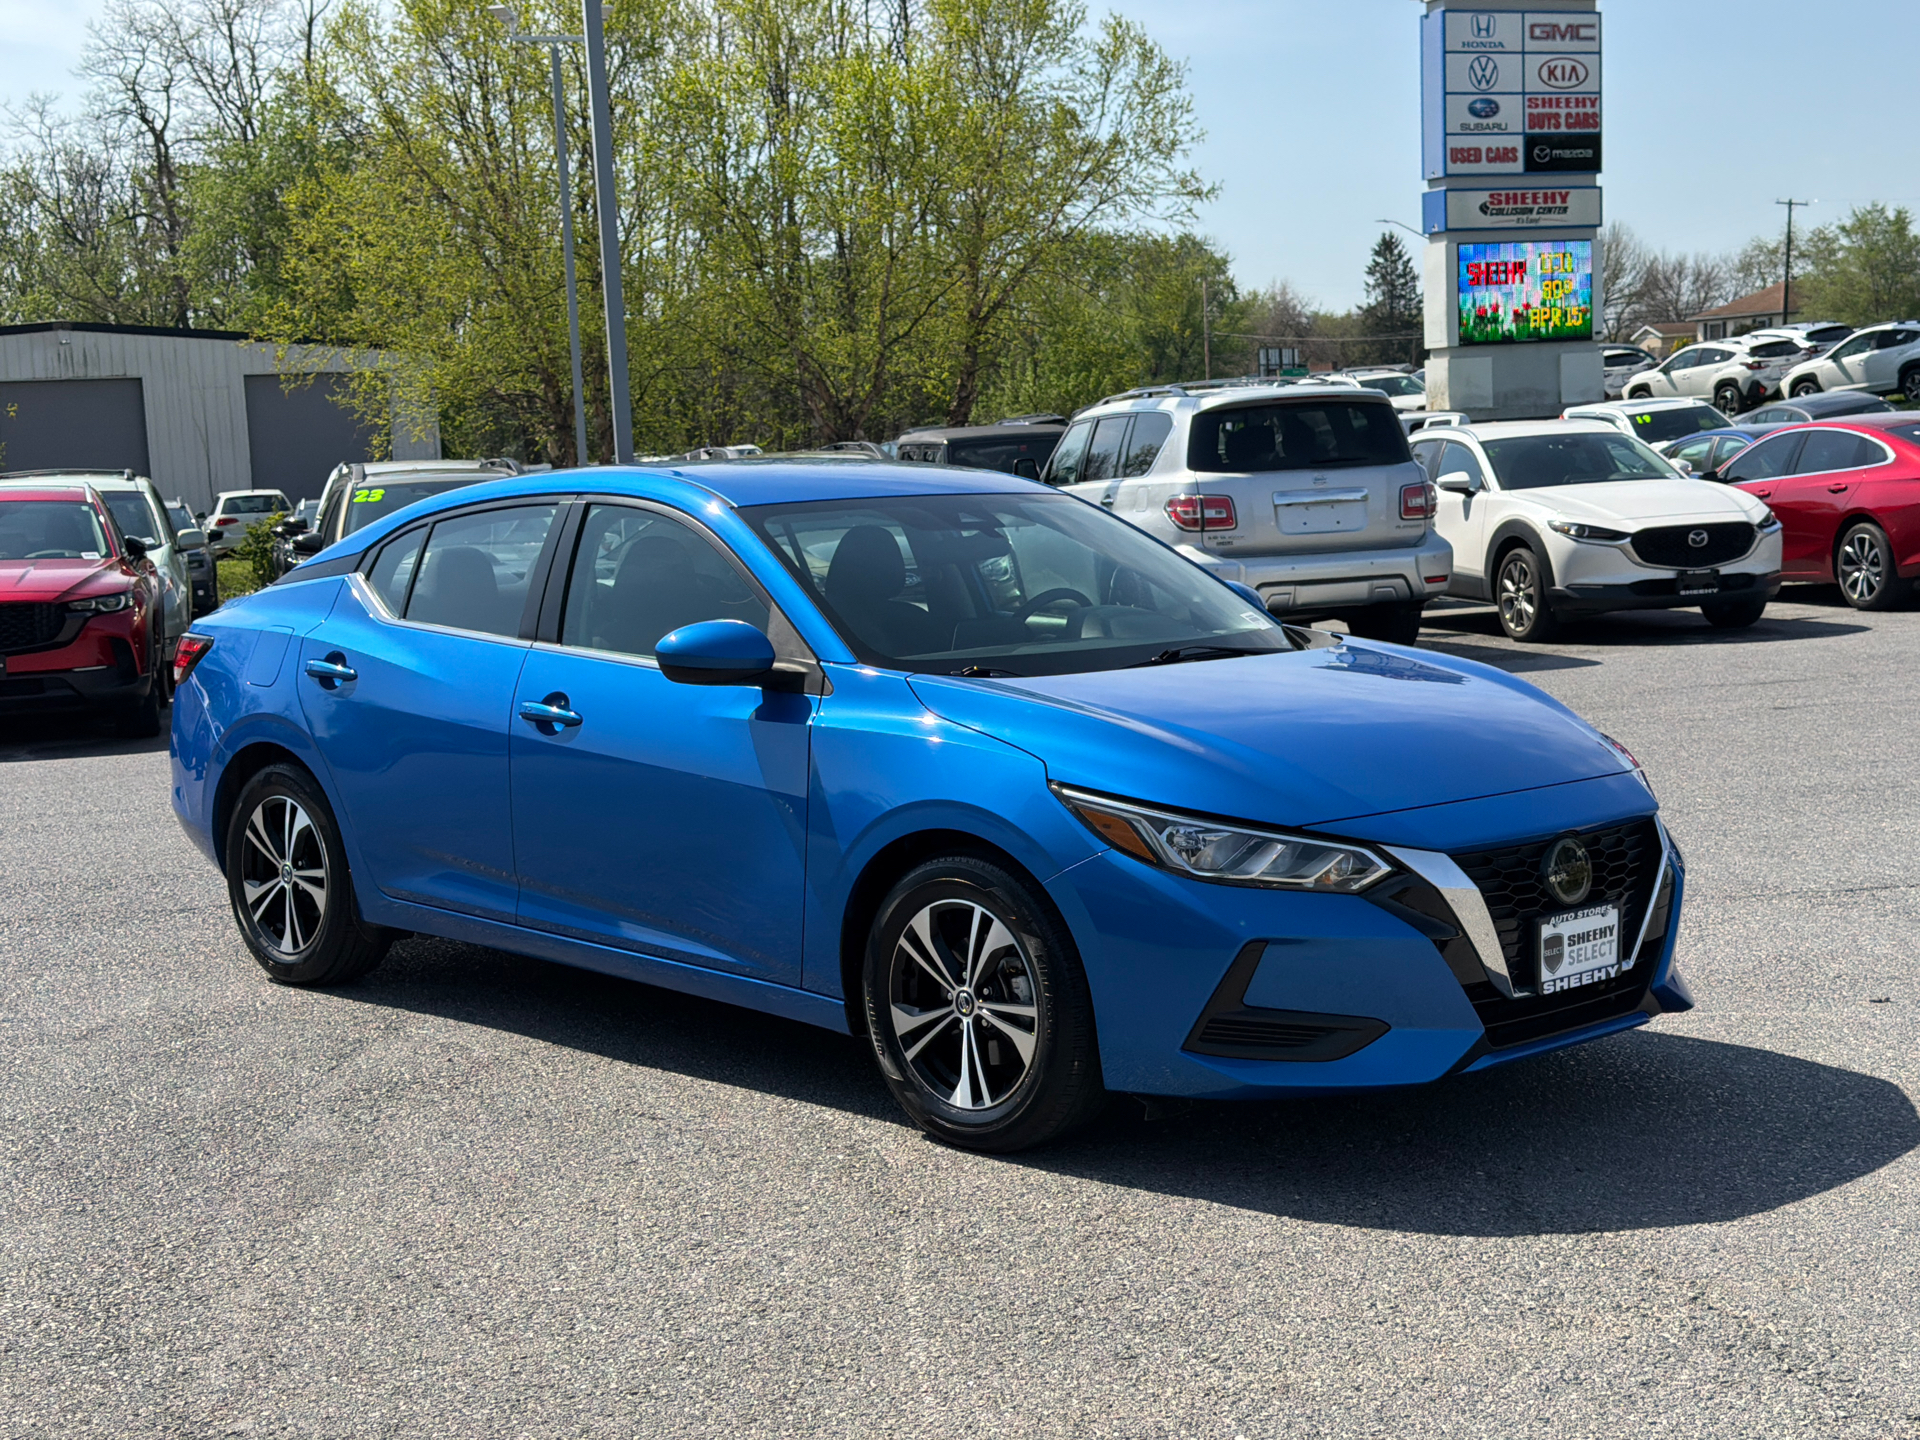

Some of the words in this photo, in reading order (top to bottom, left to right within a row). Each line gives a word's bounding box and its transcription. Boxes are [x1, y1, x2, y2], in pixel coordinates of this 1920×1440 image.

[1529, 23, 1596, 42] GMC
[1461, 41, 1505, 49] HONDA
[1547, 65, 1580, 82] KIA
[1527, 97, 1599, 109] SHEEHY
[1460, 123, 1508, 131] SUBARU
[1528, 112, 1562, 130] BUYS
[1565, 112, 1599, 130] CARS
[1450, 147, 1482, 164] USED
[1486, 147, 1518, 164] CARS
[1489, 191, 1570, 206] SHEEHY
[1489, 206, 1535, 216] COLLISION
[1536, 206, 1569, 215] CENTER
[1467, 261, 1526, 285] SHEEHY
[1530, 307, 1562, 328] APR
[1565, 306, 1583, 327] 15
[353, 489, 385, 502] 23
[1549, 912, 1575, 925] AUTO
[1567, 924, 1616, 947] SHEEHY
[1544, 946, 1563, 957] SELECT
[1568, 939, 1615, 966] SELECT
[1543, 965, 1619, 995] SHEEHY
